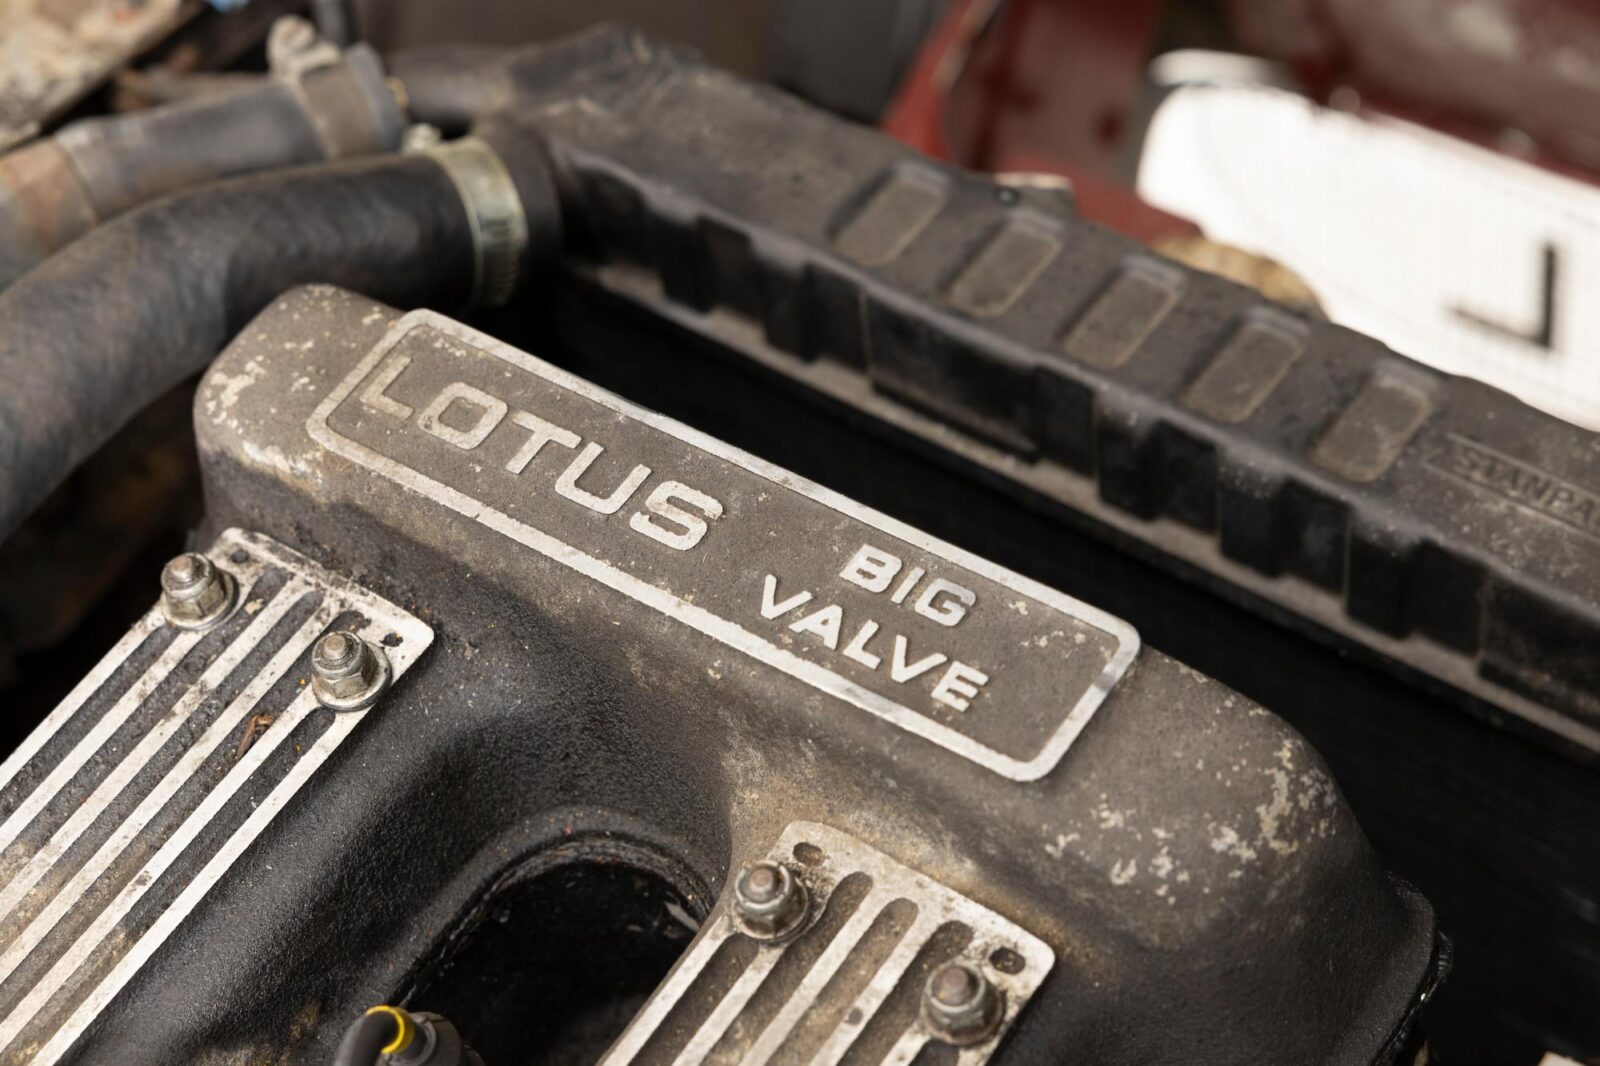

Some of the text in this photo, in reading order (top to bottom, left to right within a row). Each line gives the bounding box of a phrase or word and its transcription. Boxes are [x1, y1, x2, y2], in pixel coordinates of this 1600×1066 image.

[360, 355, 724, 551] LOTUS
[1451, 446, 1600, 528] STANPA
[839, 543, 977, 627] BIG
[760, 573, 989, 713] VALVE
